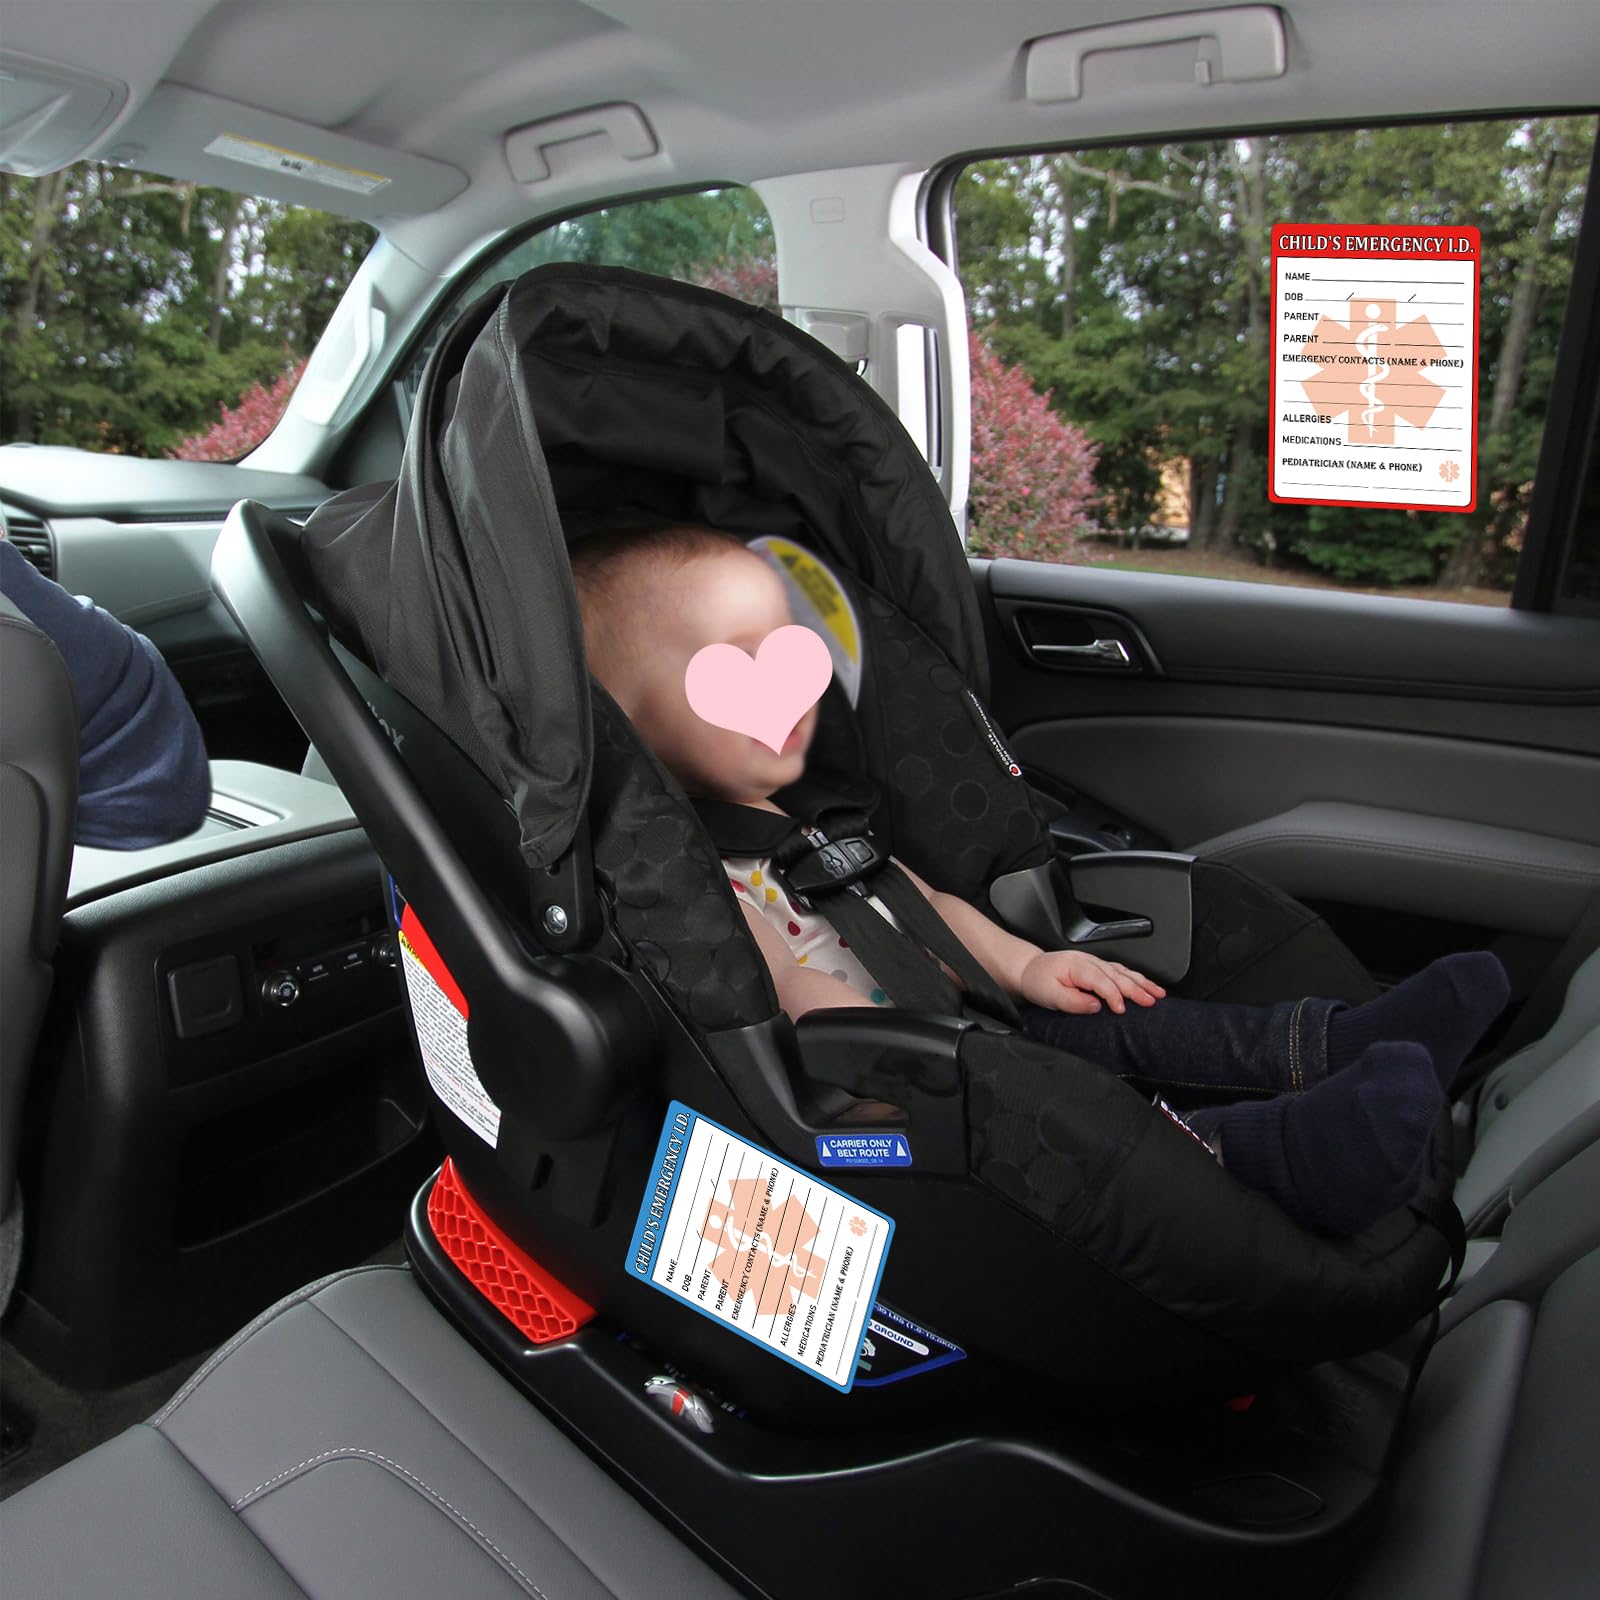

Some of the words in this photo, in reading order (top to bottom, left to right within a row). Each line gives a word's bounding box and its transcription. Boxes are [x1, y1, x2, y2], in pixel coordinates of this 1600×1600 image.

[1279, 234, 1341, 250] CHILD'S
[1345, 236, 1444, 253] EMERGENCY
[1448, 238, 1475, 253] I.D.
[1285, 272, 1311, 281] NAME
[1284, 292, 1304, 301] DOB
[1283, 312, 1319, 321] PARENT
[1283, 334, 1319, 343] PARENT
[1282, 354, 1338, 364] EMERGENCY
[1338, 356, 1385, 365] CONTACTS
[1387, 357, 1418, 367] (NAME
[1419, 358, 1427, 366] &
[1430, 359, 1464, 368] PHONE)
[1282, 414, 1332, 424] ALLERGIES
[1282, 435, 1342, 446] MEDICATIONS
[1282, 457, 1345, 469] PEDIATRICIAN
[1346, 460, 1377, 470] (NAME
[1379, 462, 1386, 470] &
[1389, 462, 1423, 473] PHONE)
[830, 1139, 868, 1148] CARRIER
[869, 1139, 892, 1148] ONLY
[837, 1149, 857, 1158] BELT
[859, 1149, 890, 1157] ROUTE
[634, 1218, 660, 1275] CHILD'S
[651, 1134, 683, 1220] EMERGENCY
[676, 1112, 691, 1135] I.D.
[731, 1271, 750, 1321] EMERGENCY
[744, 1232, 761, 1273] CONTACTS
[755, 1205, 769, 1233] (NAME
[765, 1167, 780, 1198] PHONE)
[840, 1245, 855, 1277] PHONE)
[665, 1258, 678, 1283] NAME
[681, 1274, 692, 1292] DOB
[697, 1268, 712, 1301] PARENT
[838, 1276, 846, 1284] &
[715, 1279, 730, 1311] PARENT
[830, 1284, 844, 1312] (NAME
[780, 1303, 797, 1348] ALLERGIES
[797, 1303, 818, 1357] MEDICATIONS
[815, 1311, 837, 1367] PEDIATRICIAN
[874, 1323, 914, 1348] GROUND
